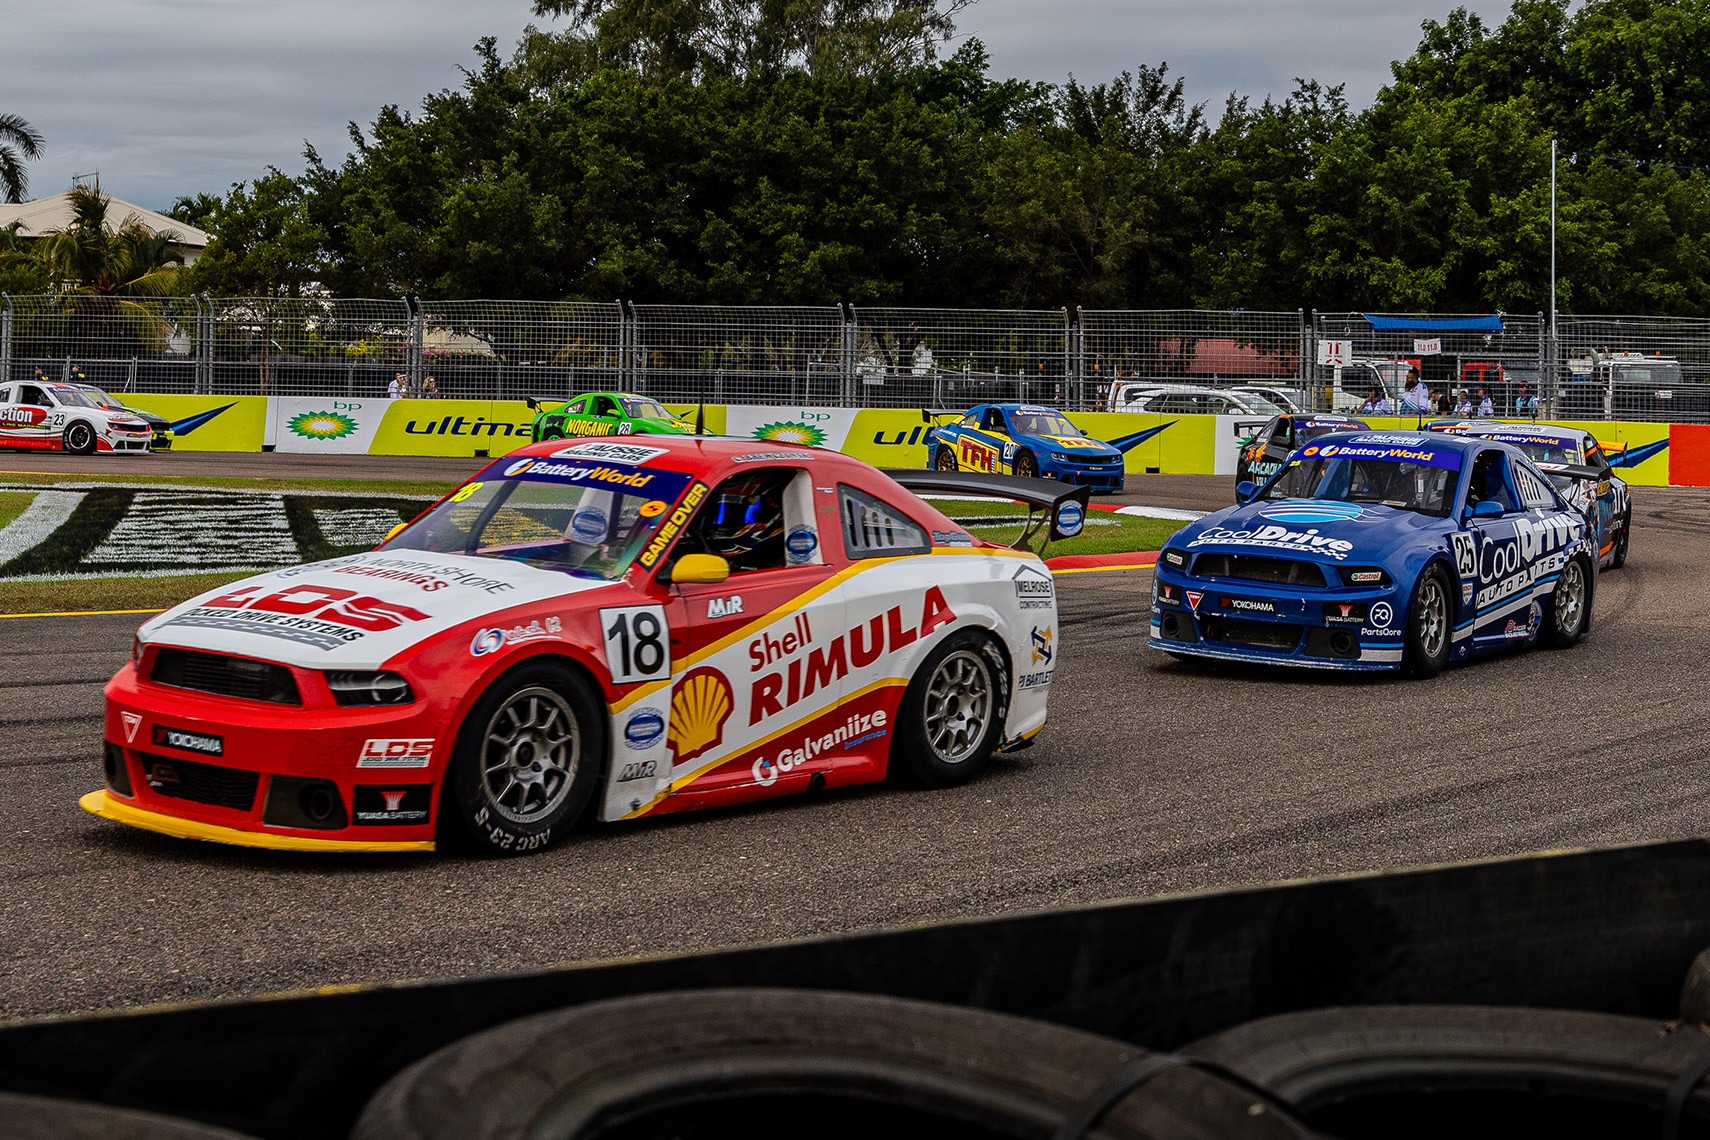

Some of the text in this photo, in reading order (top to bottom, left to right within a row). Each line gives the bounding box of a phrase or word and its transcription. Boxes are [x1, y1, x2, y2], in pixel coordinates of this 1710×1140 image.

[0, 407, 33, 423] ction
[334, 401, 363, 412] bp
[54, 413, 65, 427] 23
[801, 411, 831, 422] bp
[565, 418, 613, 437] NORGANIC
[620, 423, 631, 435] 28
[961, 439, 993, 473] TFH
[1004, 443, 1015, 458] 20
[640, 522, 679, 567] GAME
[671, 483, 708, 526] OVER
[1455, 535, 1475, 574] 25
[334, 565, 449, 592] BEARINGS
[438, 566, 515, 595] SHORE
[1018, 581, 1050, 593] MELROSE
[201, 584, 433, 632] LDS
[1020, 601, 1053, 609] CONTRACTING
[1231, 599, 1275, 613] YOKOHAMA
[1361, 627, 1402, 636] PartsQore
[608, 612, 665, 677] 18
[749, 611, 813, 673] Shell
[748, 585, 958, 728] RIMULA
[365, 741, 433, 757] LDS
[777, 709, 887, 772] Galvaniize
[844, 729, 887, 750] Insurance
